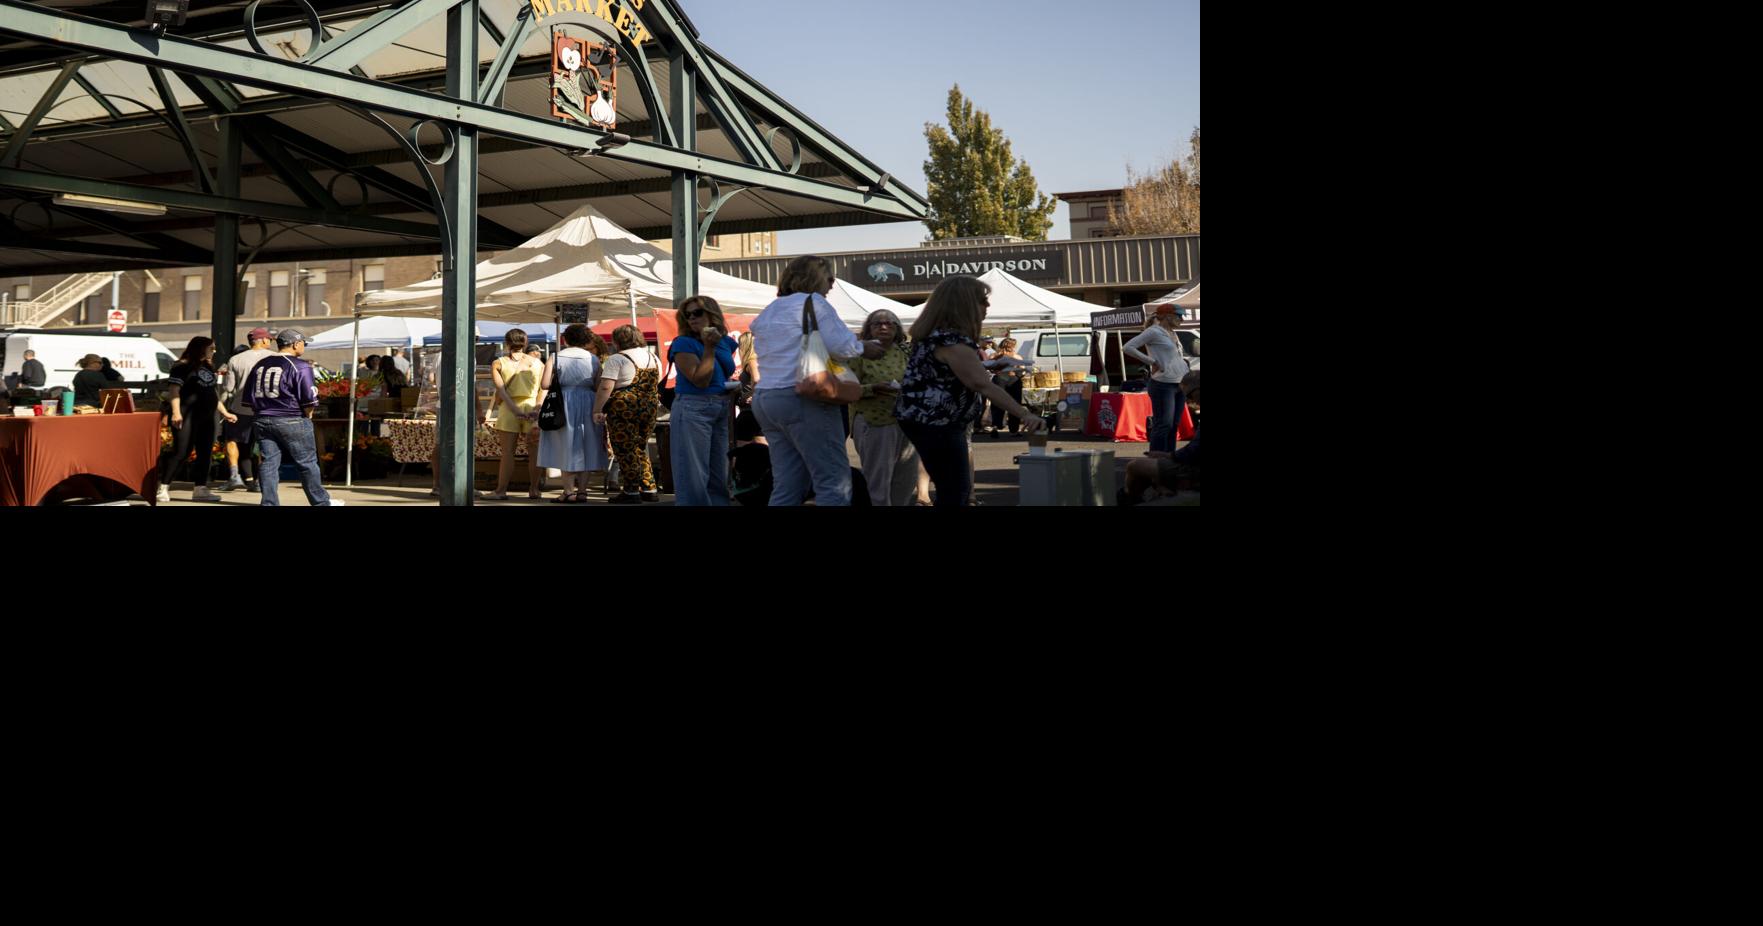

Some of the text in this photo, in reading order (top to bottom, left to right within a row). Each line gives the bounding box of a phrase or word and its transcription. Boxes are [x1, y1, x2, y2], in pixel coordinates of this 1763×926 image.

[530, 0, 652, 48] MARKET
[1093, 312, 1142, 327] INFORMATION
[111, 360, 146, 369] MILL
[255, 366, 284, 398] 10
